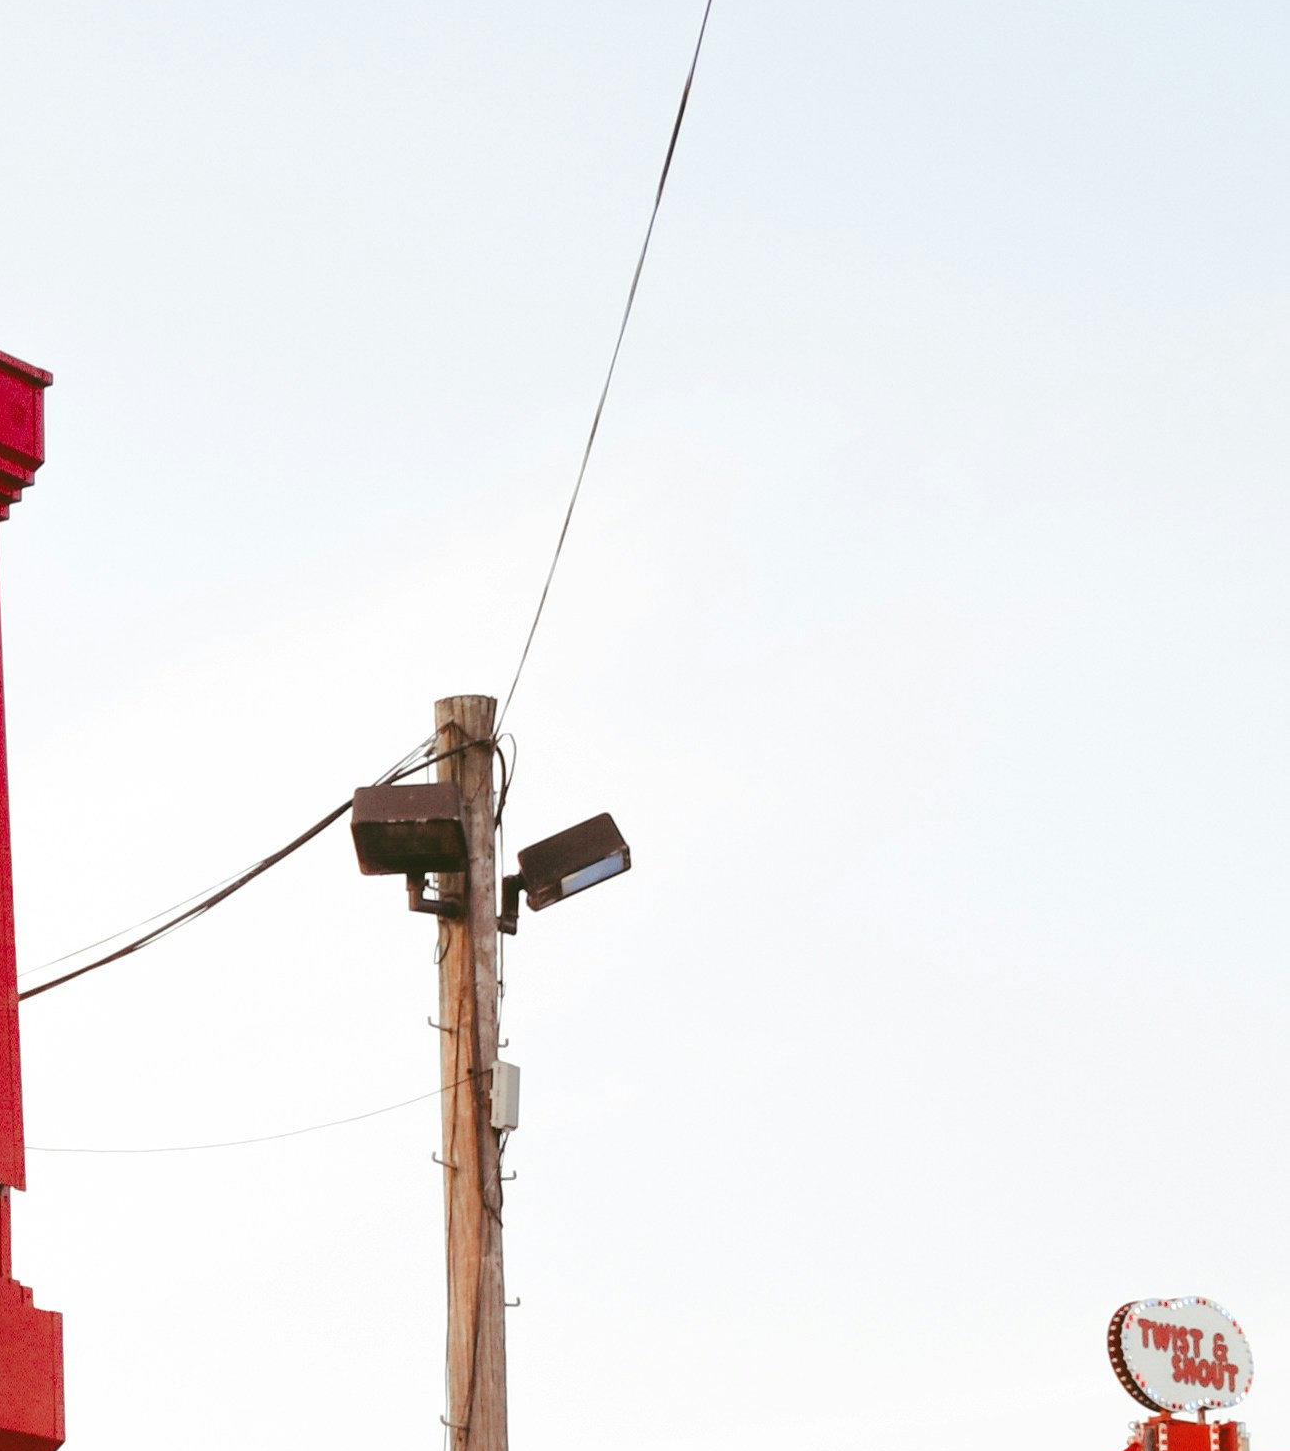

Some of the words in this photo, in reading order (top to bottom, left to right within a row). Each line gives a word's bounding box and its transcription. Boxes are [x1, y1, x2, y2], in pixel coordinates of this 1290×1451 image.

[1137, 1318, 1204, 1358] TWIST
[1213, 1332, 1229, 1363] &
[1171, 1353, 1239, 1393] SHOUT
